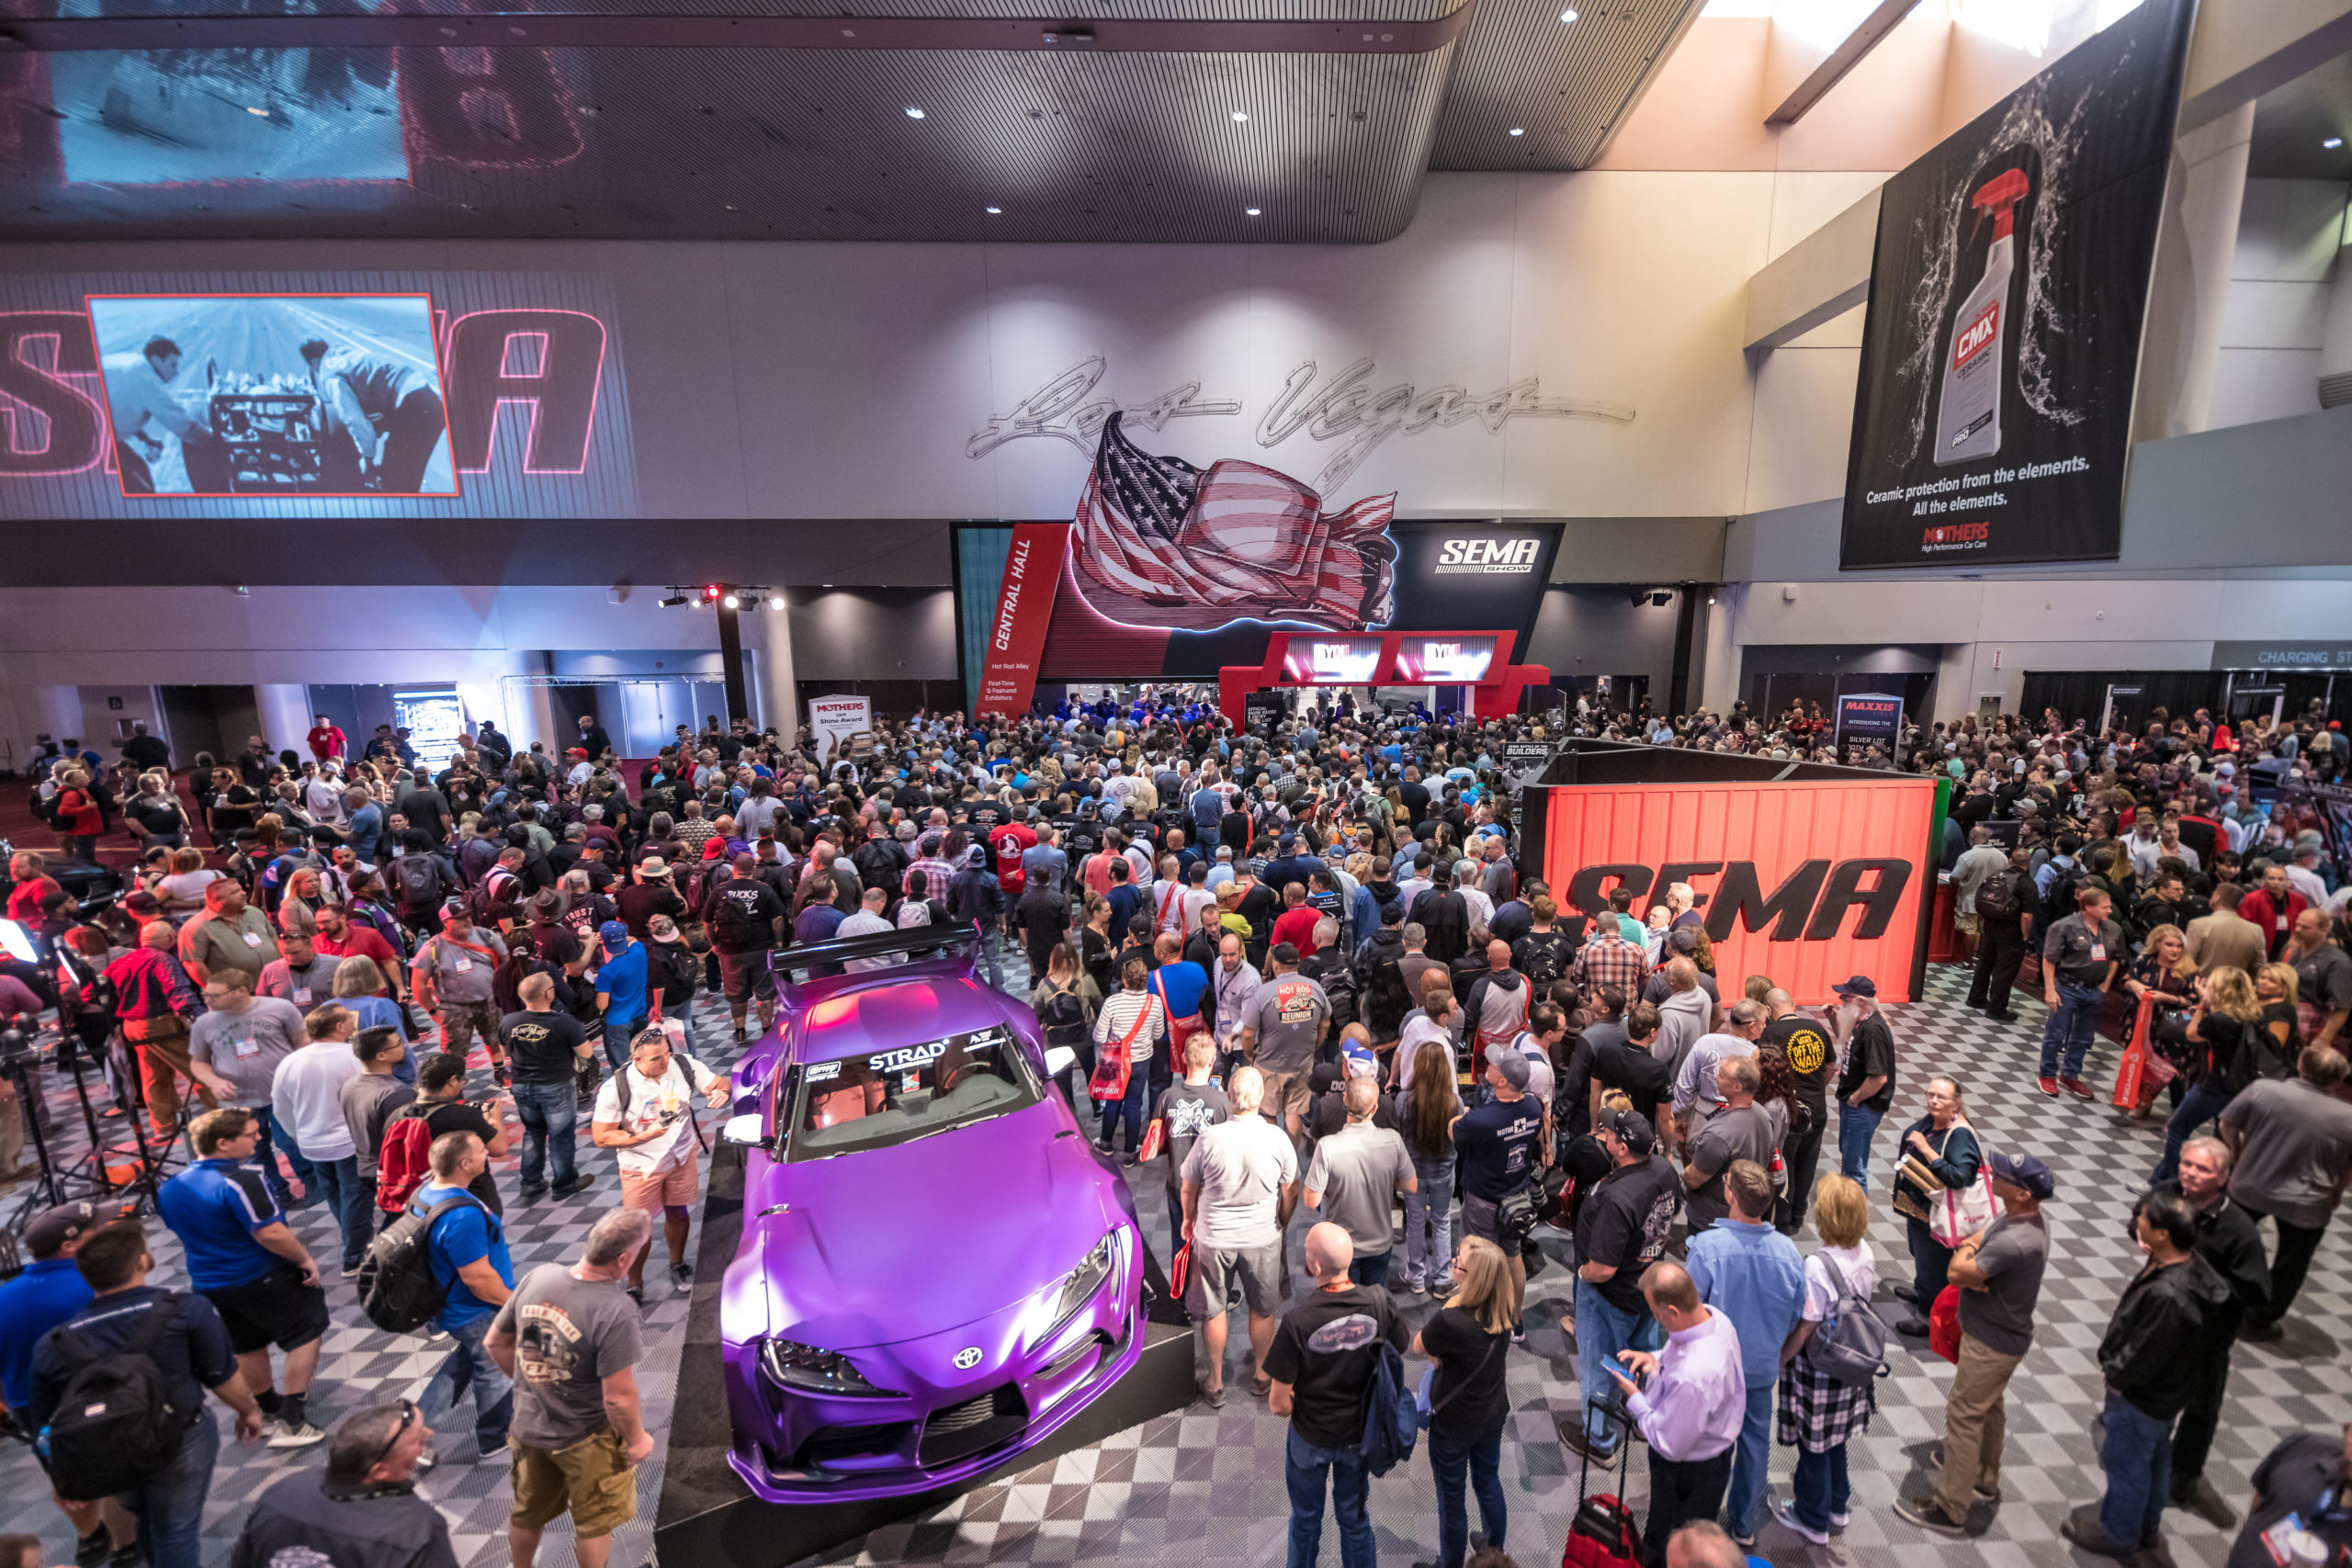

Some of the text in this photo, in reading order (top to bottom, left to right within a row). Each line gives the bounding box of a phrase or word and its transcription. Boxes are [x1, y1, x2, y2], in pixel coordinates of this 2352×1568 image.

[1957, 309, 1996, 359] CMX
[1256, 356, 1636, 497] Vegas
[1951, 429, 1969, 448] PRO
[1866, 456, 2090, 504] Ceramic protection from the elements.
[1912, 491, 2007, 516] All the elements.
[1923, 521, 1989, 544] MOTHERS
[1439, 539, 1541, 565] SEMA
[1921, 544, 1932, 553] High
[1933, 542, 1963, 551] Performance
[1974, 540, 1987, 548] Care
[995, 538, 1031, 651] CENTRAL HALL
[2258, 651, 2328, 663] CHARGING
[817, 703, 865, 712] MOTHERS
[1845, 701, 1894, 712] MAXXIS
[1849, 736, 1872, 744] SILVER
[1557, 858, 1913, 946] SEMA
[1279, 986, 1311, 995] HOT ROD
[1281, 1010, 1312, 1021] REUNION
[244, 1020, 272, 1031] OHIO
[1806, 1041, 1821, 1055] THE
[869, 1042, 946, 1070] STRAD
[1794, 1053, 1821, 1068] WALL
[1497, 1125, 1514, 1137] MOTOR
[1640, 1245, 1661, 1258] WELD
